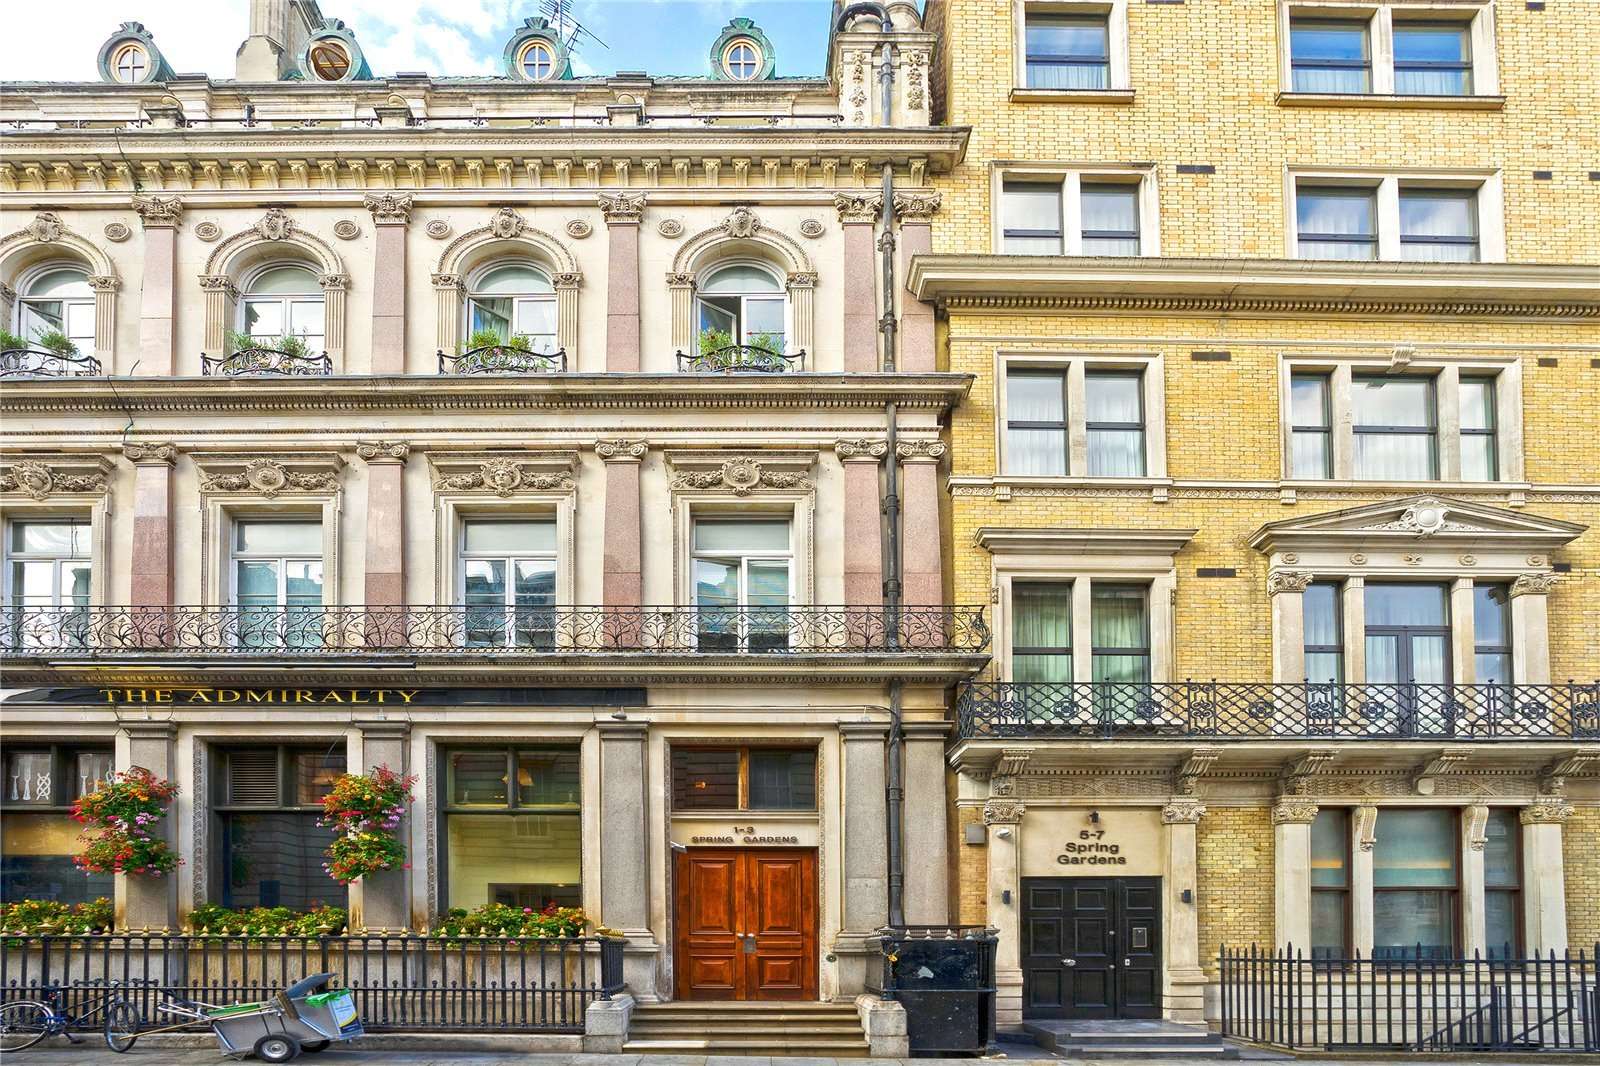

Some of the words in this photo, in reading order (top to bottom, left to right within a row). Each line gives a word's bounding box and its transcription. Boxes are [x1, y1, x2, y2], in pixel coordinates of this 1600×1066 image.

[100, 689, 174, 703] THE
[189, 689, 420, 703] ADMIRALTY
[733, 826, 755, 834] 1-3
[1079, 830, 1105, 840] 5-7
[691, 836, 735, 844] SPRING
[743, 836, 799, 844] GARDENS
[1065, 842, 1120, 855] Spring
[1057, 854, 1127, 865] Gardens
